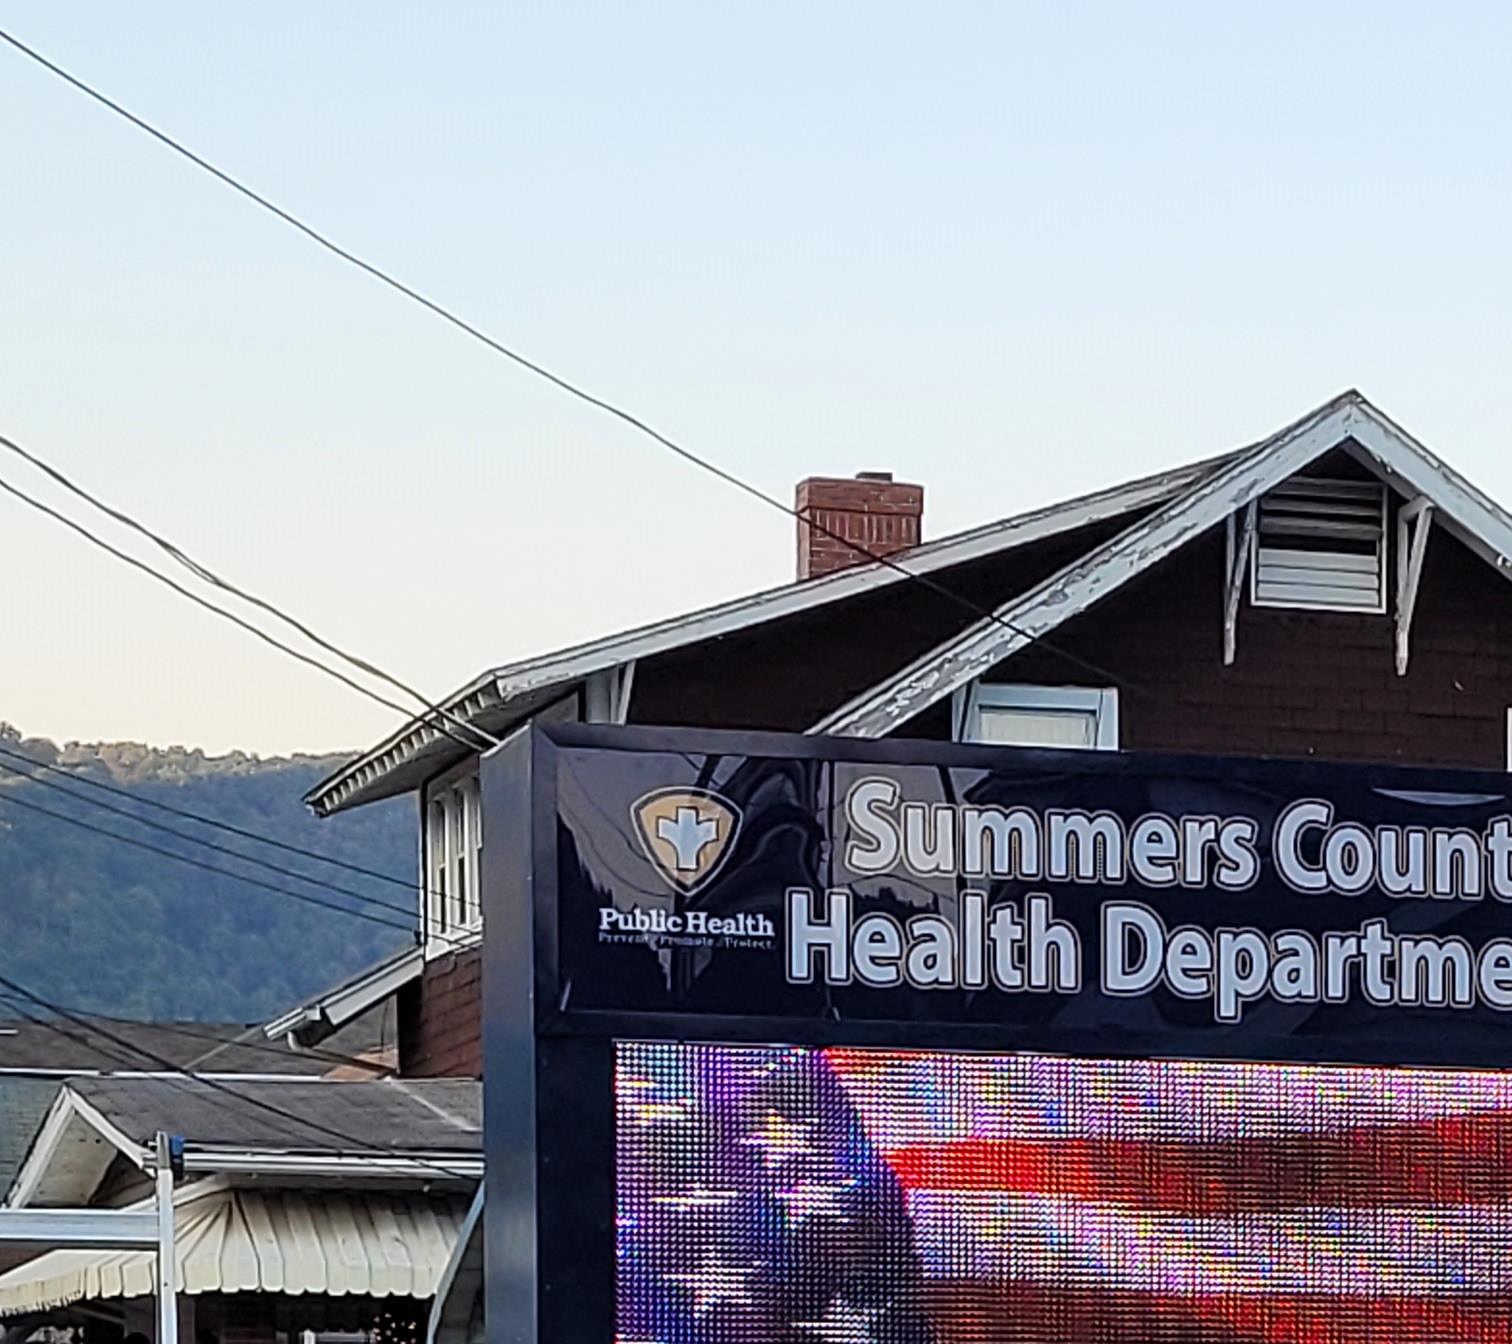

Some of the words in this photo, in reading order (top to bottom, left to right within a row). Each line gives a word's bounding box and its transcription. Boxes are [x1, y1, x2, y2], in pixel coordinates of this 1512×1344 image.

[845, 776, 1259, 890] Summers
[599, 908, 683, 932] Public
[684, 911, 775, 936] Health
[785, 887, 1082, 993] Health
